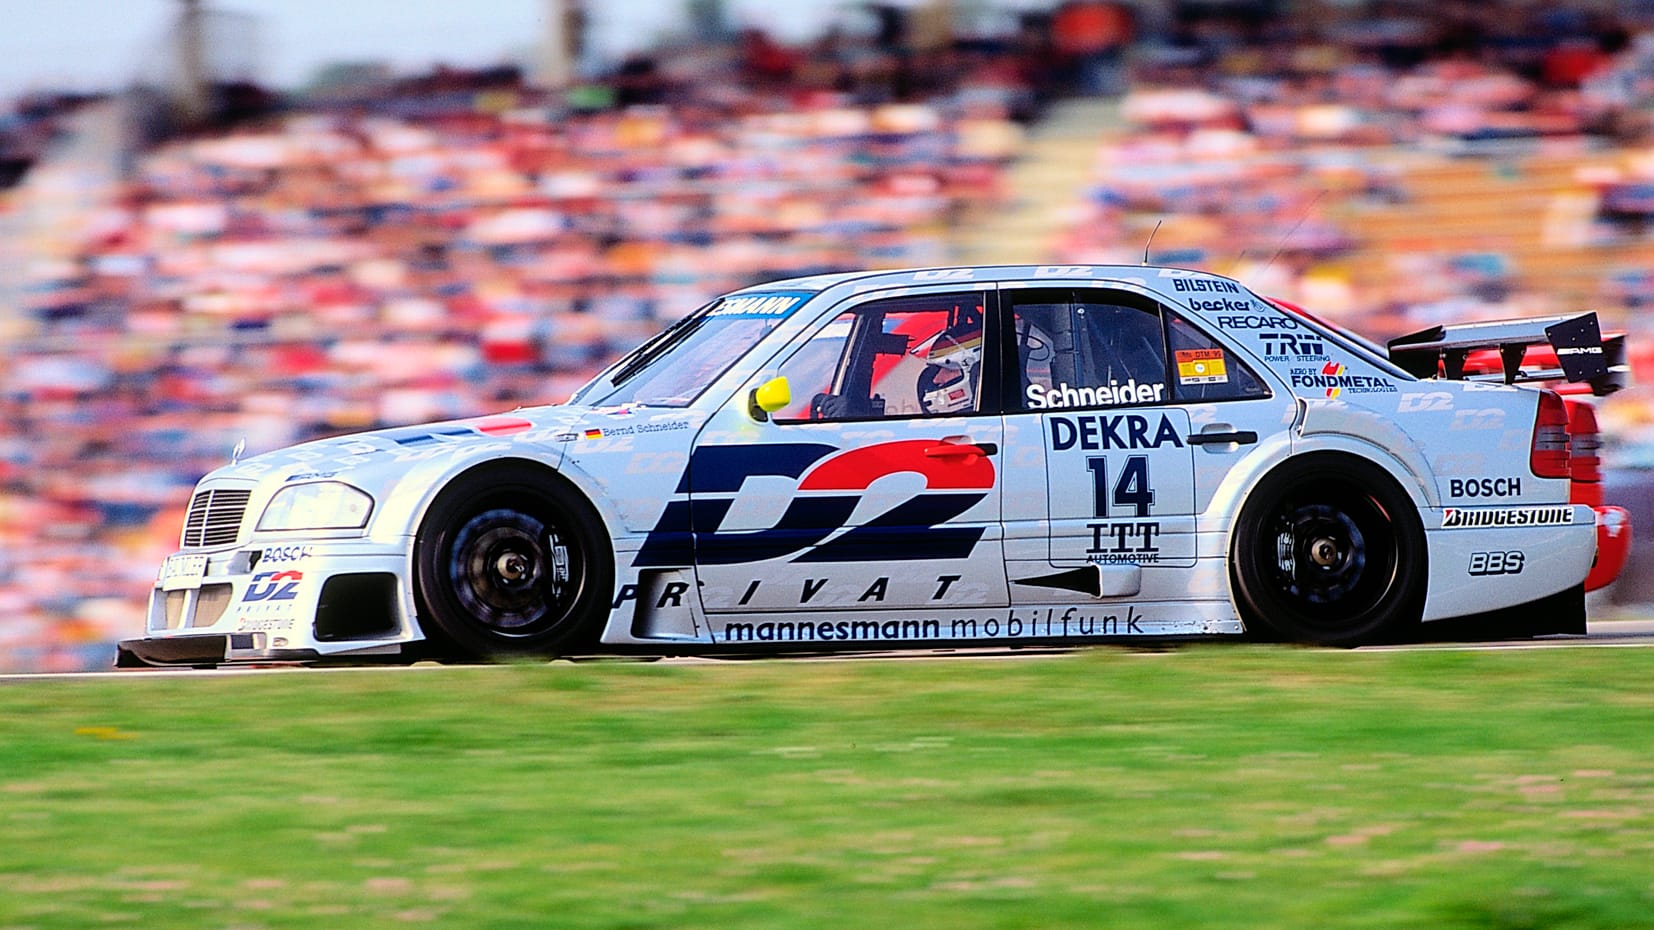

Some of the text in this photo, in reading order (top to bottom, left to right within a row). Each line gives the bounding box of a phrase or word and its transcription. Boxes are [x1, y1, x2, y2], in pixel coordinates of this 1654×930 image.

[1172, 278, 1239, 293] BILSTEIN
[1190, 298, 1250, 311] becker
[1217, 316, 1299, 329] RECARO
[1259, 333, 1323, 355] TRW
[1564, 346, 1603, 355] AMG
[1291, 376, 1395, 388] FONDMETAL
[1026, 379, 1165, 409] Schneider
[602, 420, 689, 437] Bernd Schneider
[1050, 412, 1184, 451] DEKRA
[1086, 453, 1156, 519] 14
[1450, 478, 1521, 498] BOSCH
[631, 440, 996, 567] D2
[1443, 507, 1573, 528] BRIDGESTONE
[1086, 523, 1160, 553] ITT
[262, 546, 312, 563] BOSCH
[1086, 553, 1160, 565] AUTOMOTIVE
[1467, 551, 1525, 577] BBS
[242, 570, 303, 602] D2
[725, 605, 1144, 641] mannesmann mobilfunk
